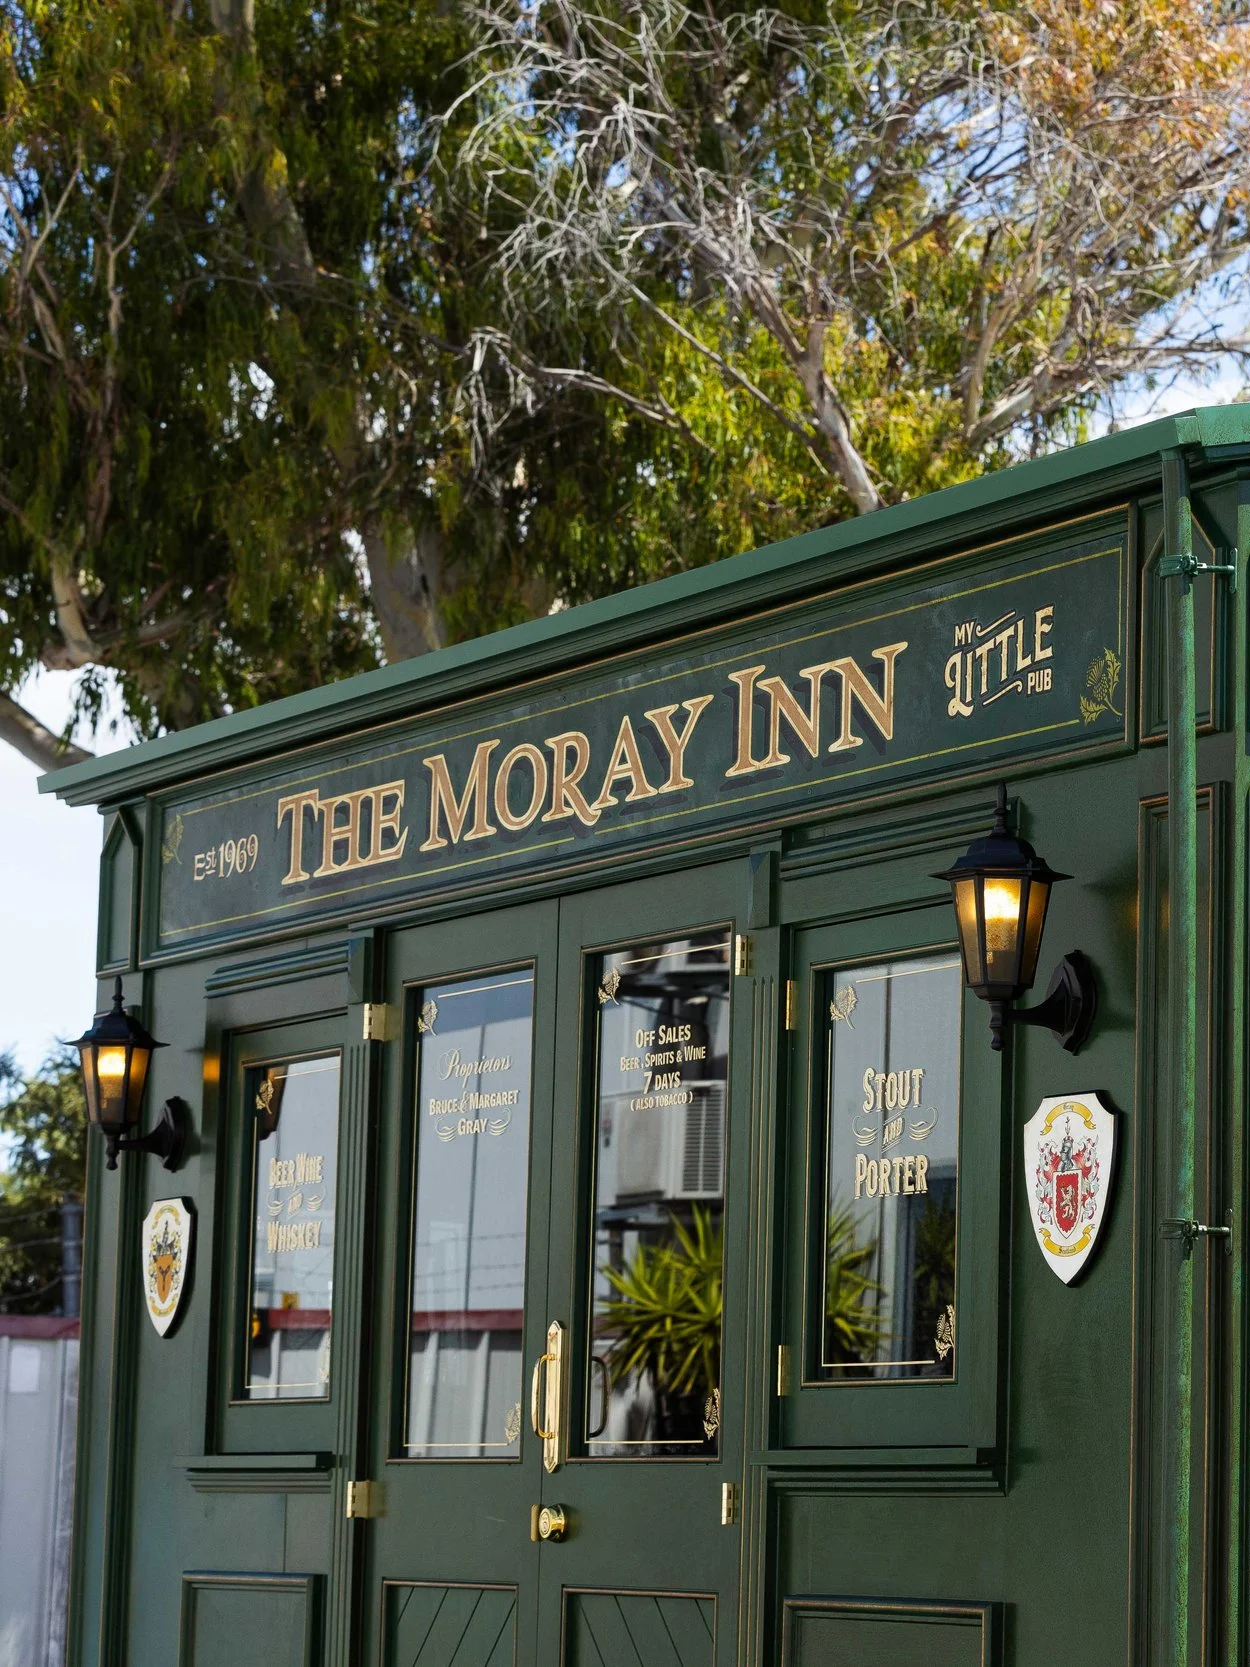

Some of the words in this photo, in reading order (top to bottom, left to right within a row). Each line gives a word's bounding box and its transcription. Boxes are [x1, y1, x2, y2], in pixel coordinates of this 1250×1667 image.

[954, 620, 976, 647] MY
[944, 605, 1054, 717] LITTLE
[1026, 667, 1052, 695] PUB
[277, 779, 408, 885] THE
[419, 694, 715, 851] MORAY
[725, 641, 908, 778] INN
[193, 846, 217, 881] Est
[218, 833, 259, 878] 1969
[635, 1028, 656, 1049] OFF
[658, 1024, 692, 1045] SALES
[440, 1047, 512, 1089] Proprietors
[644, 1051, 675, 1068] SPIRITS
[676, 1049, 683, 1063] &
[684, 1045, 707, 1062] WINE
[643, 1070, 653, 1095] 7
[654, 1071, 682, 1091] DAYS
[862, 1067, 926, 1113] STOUT
[429, 1098, 459, 1116] BRUCE
[469, 1089, 519, 1110] MARGARET
[457, 1118, 488, 1135] GRAY
[882, 1117, 905, 1147] AND
[295, 1152, 323, 1185] WINE
[854, 1153, 929, 1200] PORTER
[267, 1220, 321, 1253] WHISKEY
